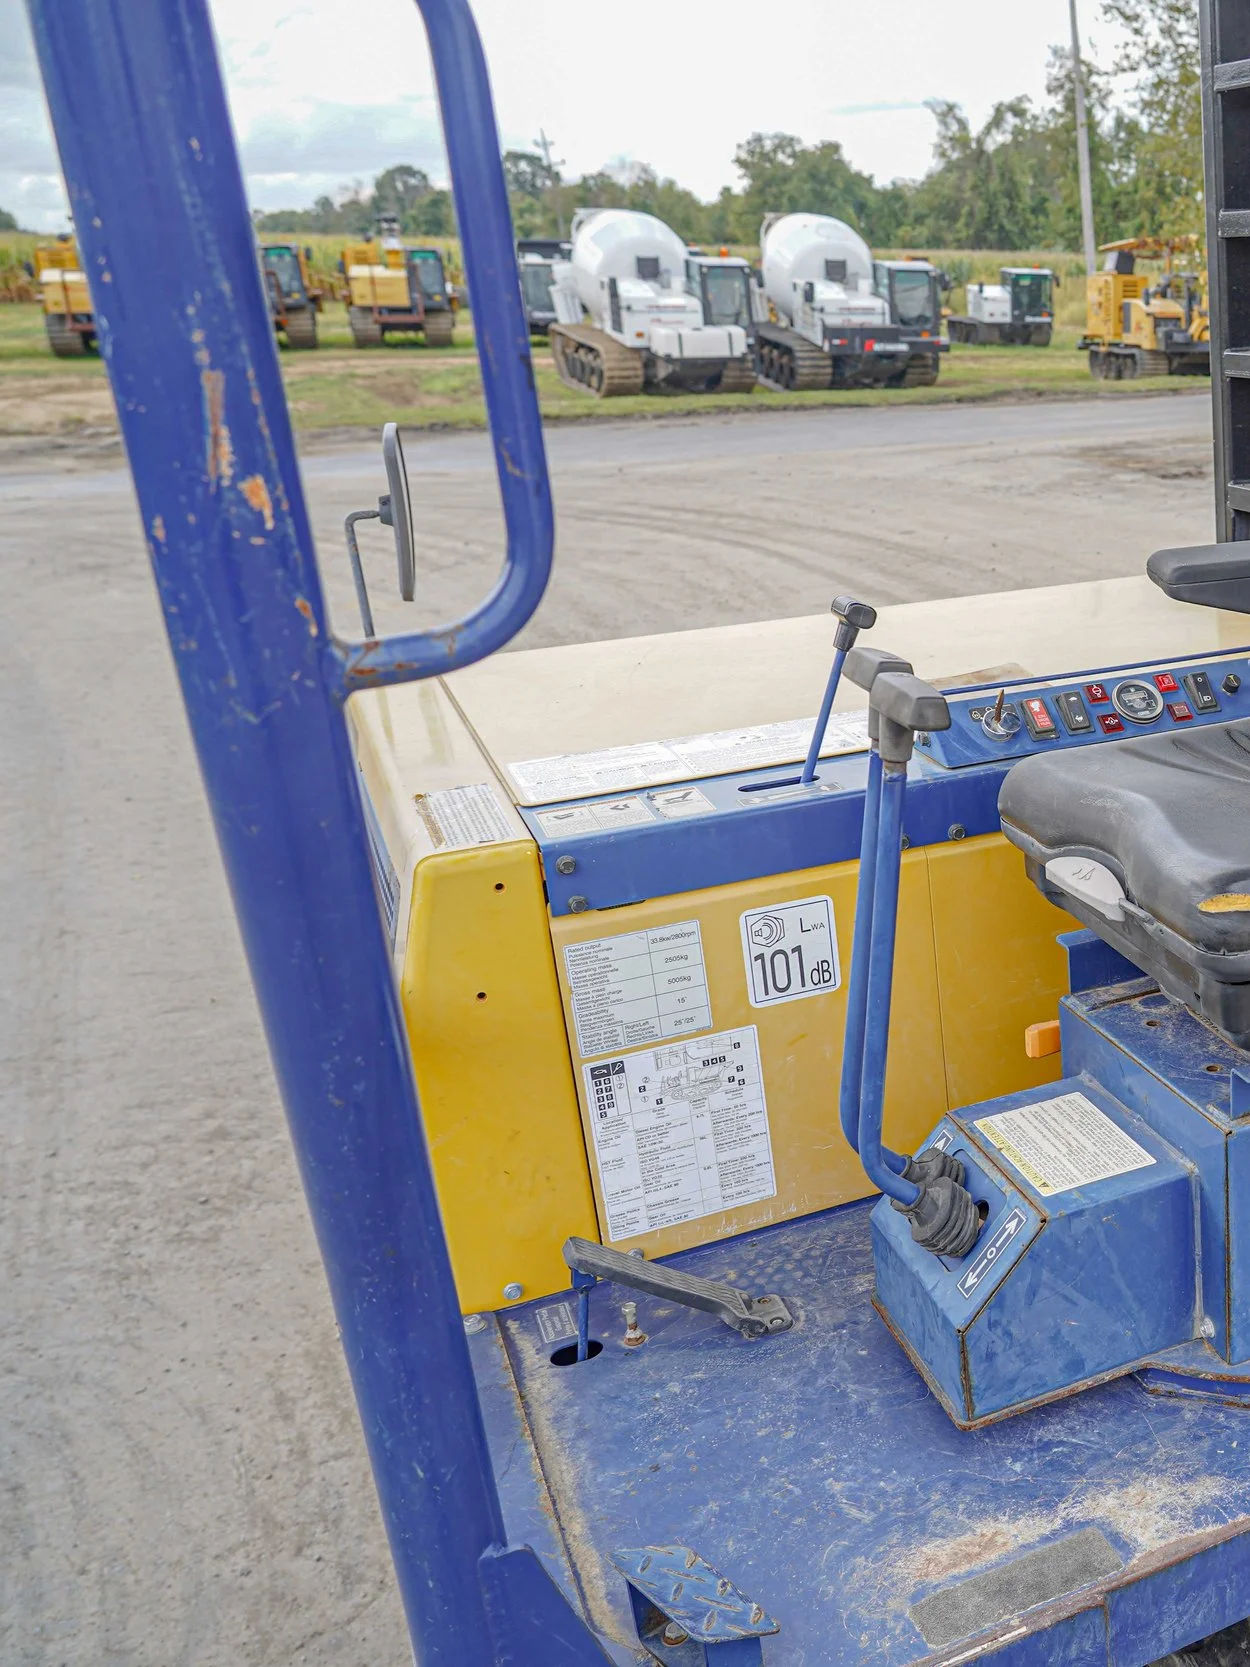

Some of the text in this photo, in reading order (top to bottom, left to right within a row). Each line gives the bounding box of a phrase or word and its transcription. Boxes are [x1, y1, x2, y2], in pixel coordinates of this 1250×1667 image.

[584, 943, 601, 951] output
[664, 954, 688, 963] 2505kg
[571, 966, 597, 976] Operating
[753, 944, 832, 996] 101 dB
[667, 974, 692, 984] 5005kg
[574, 990, 591, 998] Gross
[578, 1008, 609, 1018] Gradeability
[624, 1020, 649, 1030] Right/Left
